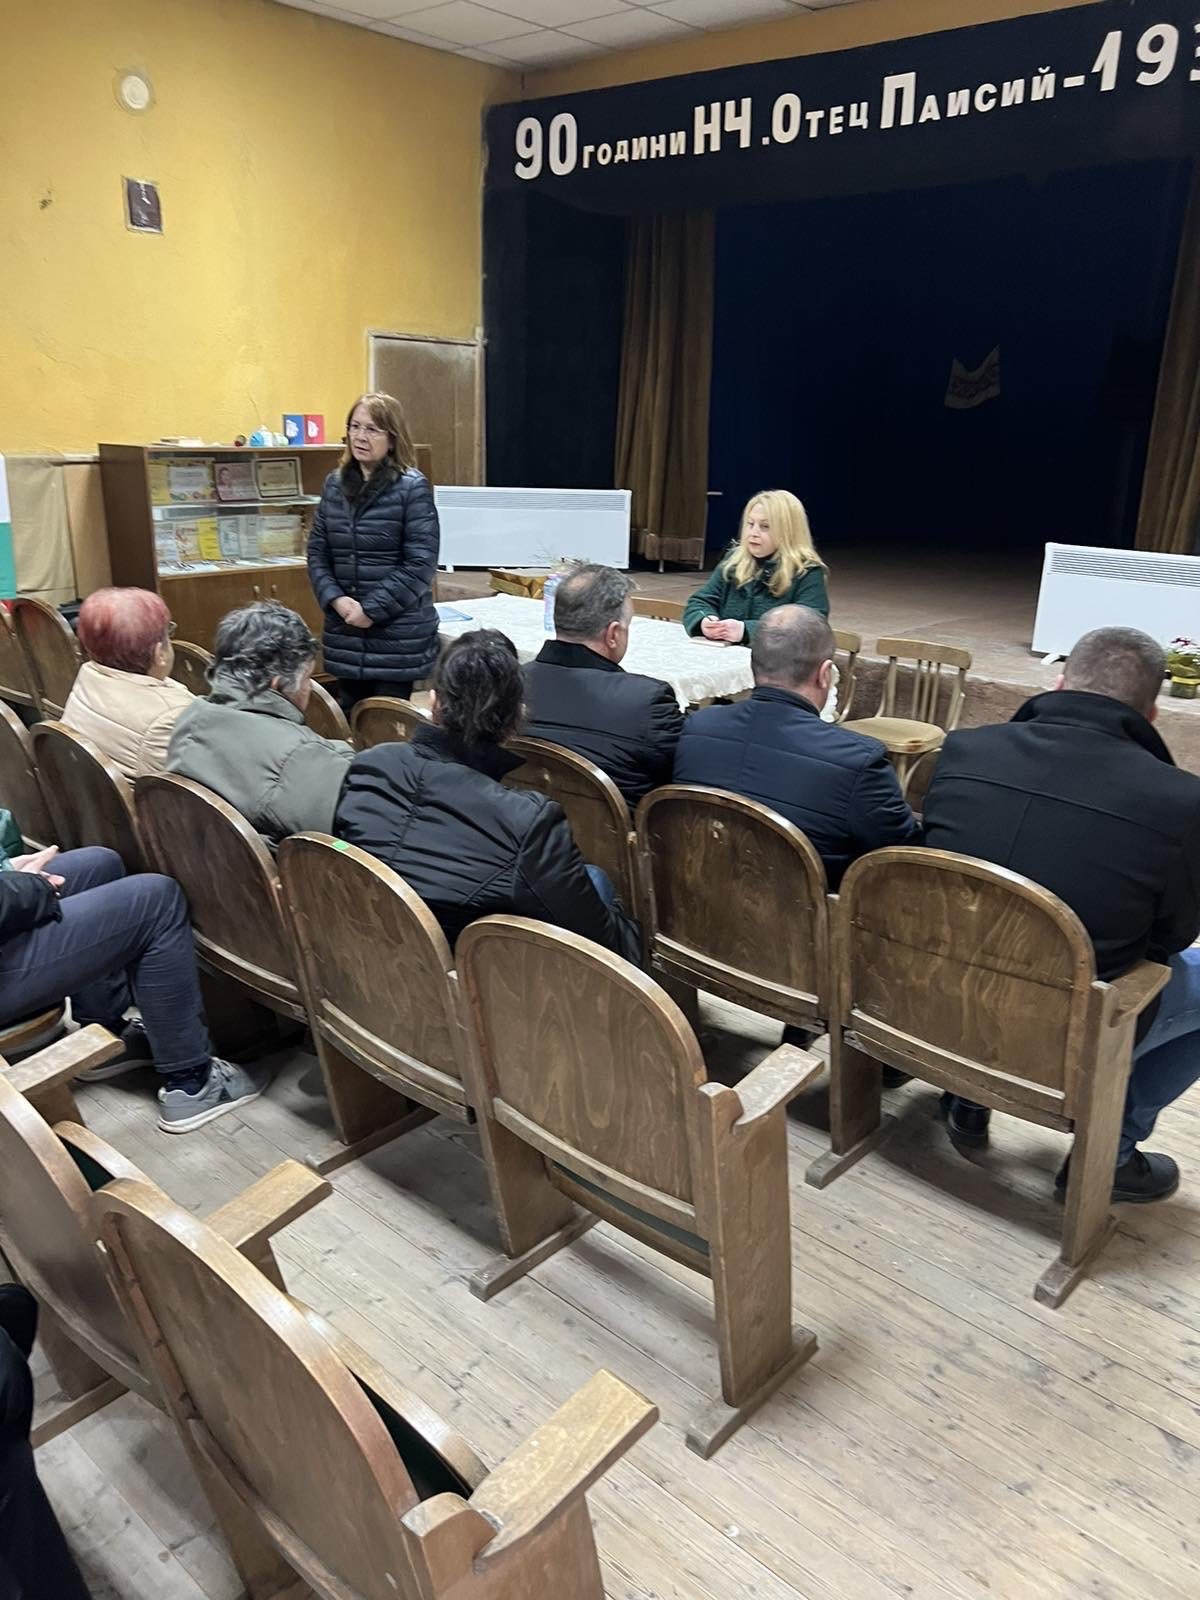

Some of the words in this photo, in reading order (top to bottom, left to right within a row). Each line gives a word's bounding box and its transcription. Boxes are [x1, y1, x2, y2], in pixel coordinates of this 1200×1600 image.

[514, 112, 578, 180] 90
[582, 131, 687, 169] години
[1091, 23, 1200, 92] 19
